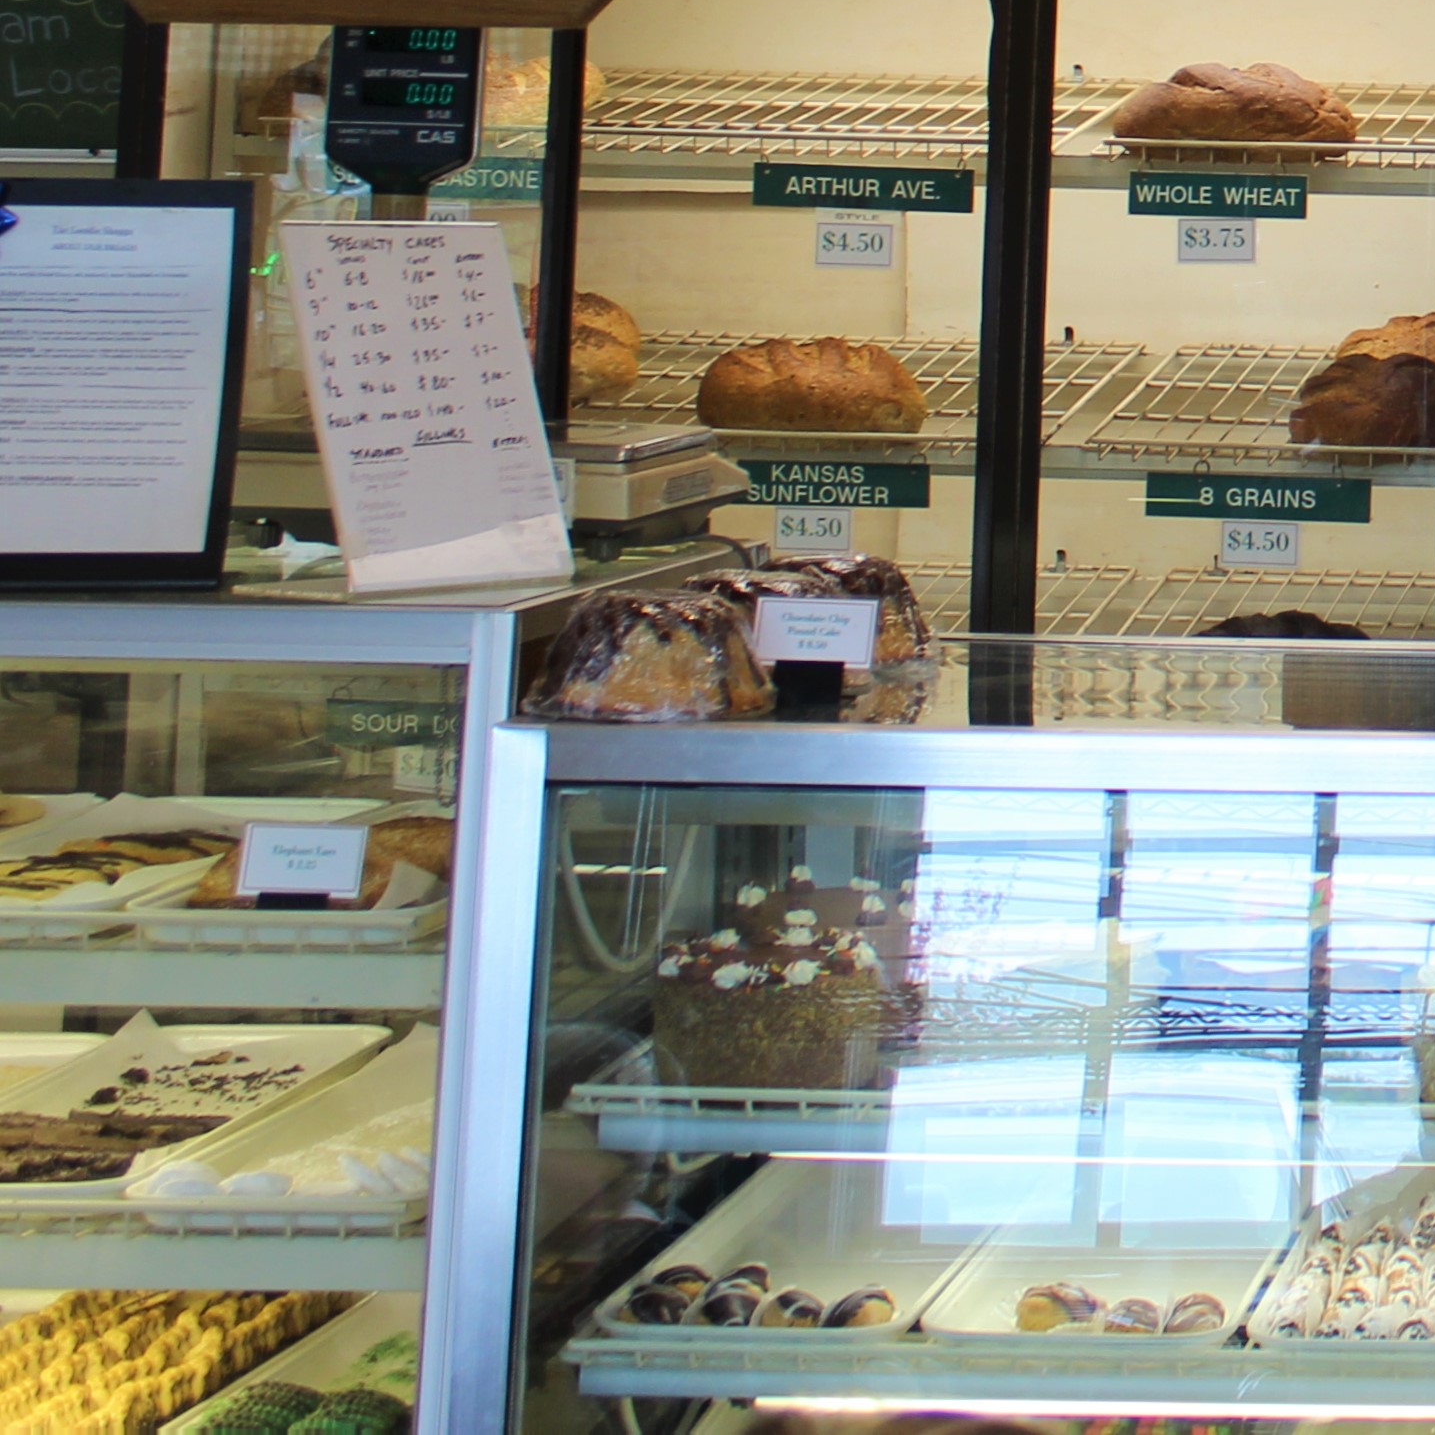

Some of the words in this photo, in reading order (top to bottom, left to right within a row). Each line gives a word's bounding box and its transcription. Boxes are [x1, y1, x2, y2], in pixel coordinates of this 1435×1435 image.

[416, 130, 455, 144] CAS
[784, 176, 880, 197] ARTHUR
[891, 180, 941, 200] AVE.
[1136, 184, 1213, 204] WHOLE
[1223, 187, 1301, 207] WHEAT
[834, 212, 880, 220] STYLE
[327, 234, 394, 254] SPECIALTY
[821, 231, 884, 253] $4.50
[1184, 226, 1245, 249] $3.75
[771, 464, 865, 484] KANSAS
[747, 484, 889, 505] SUNFLOWER
[1200, 487, 1214, 505] 8
[1226, 487, 1316, 509] GRAINS
[780, 515, 842, 538] $4.50
[1227, 530, 1289, 552] $4.50
[352, 713, 418, 733] SOUR
